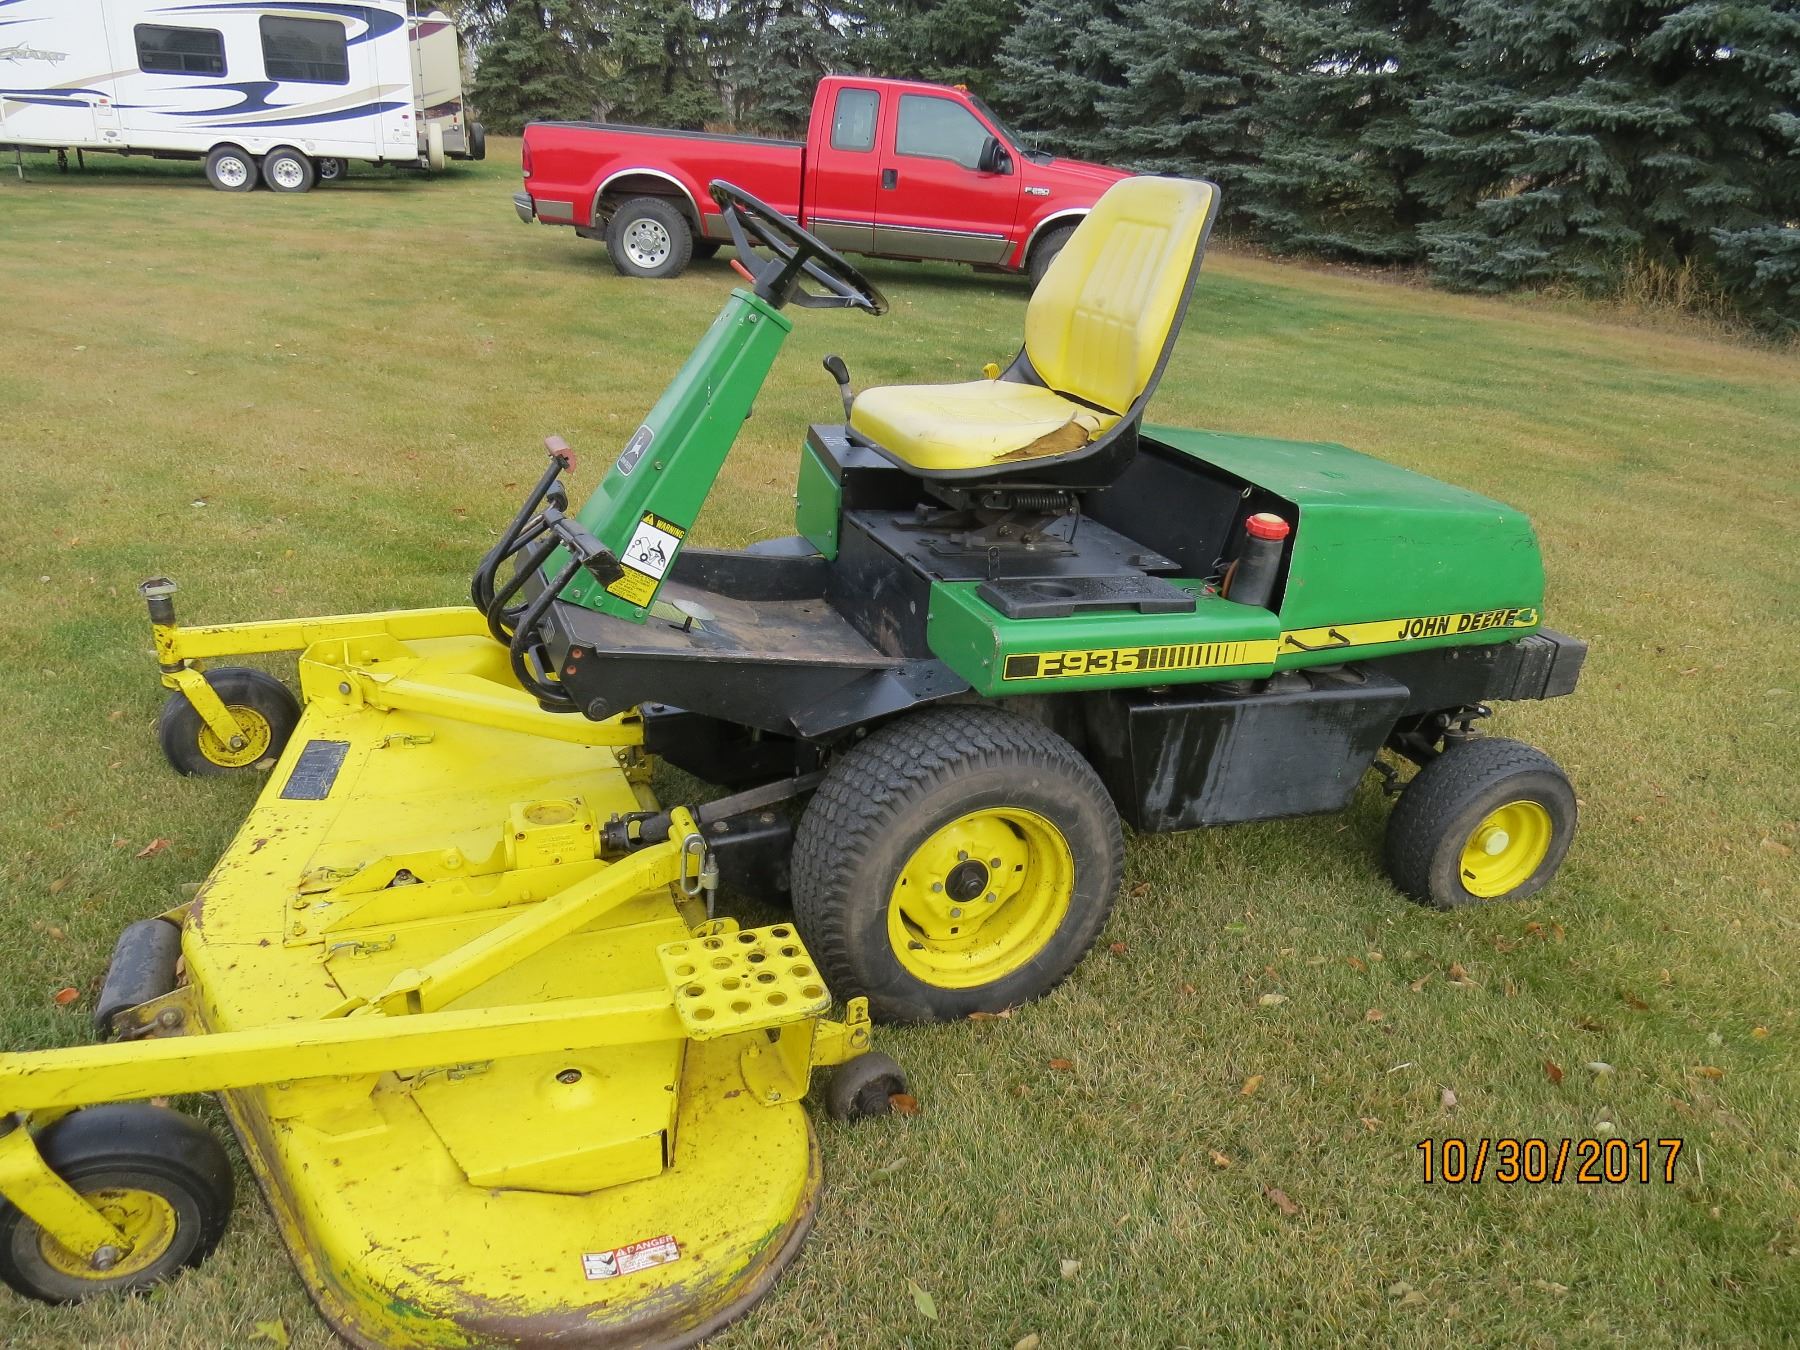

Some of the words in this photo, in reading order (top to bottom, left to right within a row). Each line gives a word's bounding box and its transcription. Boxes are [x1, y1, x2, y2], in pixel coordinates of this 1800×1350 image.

[656, 519, 685, 540] WARNING
[1398, 616, 1450, 639] JOHN
[1457, 609, 1518, 632] DEERE
[1036, 649, 1140, 678] F935
[626, 1235, 674, 1255] DANGER
